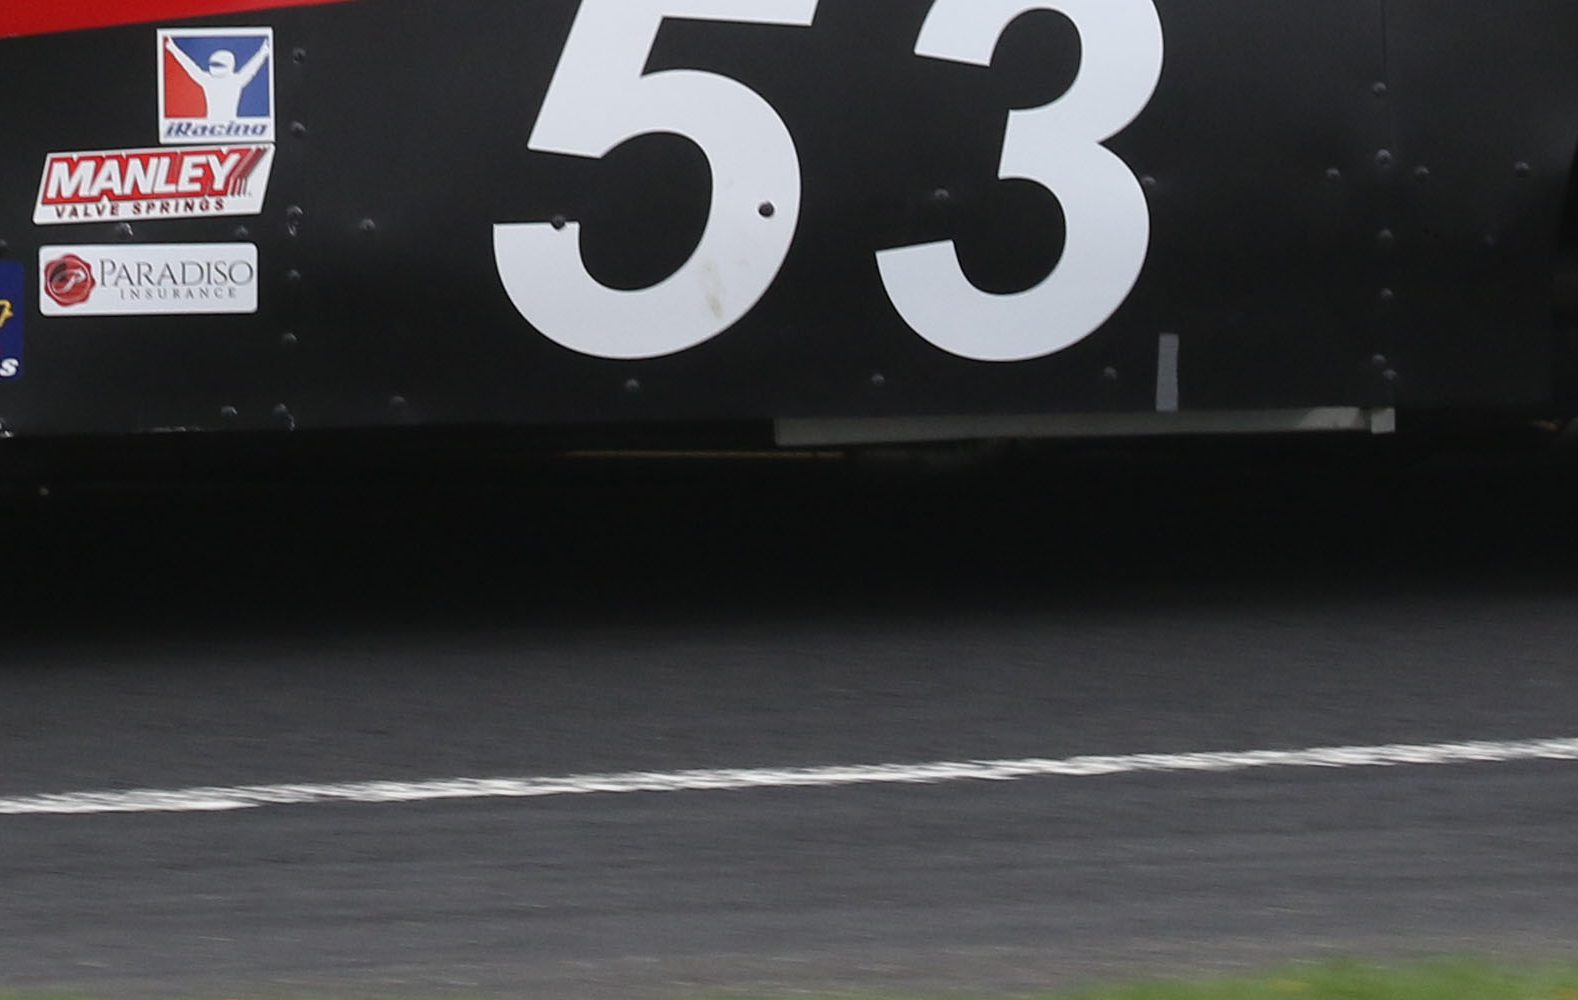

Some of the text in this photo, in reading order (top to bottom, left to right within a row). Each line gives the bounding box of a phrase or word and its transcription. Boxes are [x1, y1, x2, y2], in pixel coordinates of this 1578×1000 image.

[166, 120, 268, 138] iRacing
[46, 152, 241, 199] MANLEY
[55, 198, 226, 219] VALVE SPRINGS
[99, 258, 254, 287] PARADISO
[120, 287, 237, 300] INSURANCE
